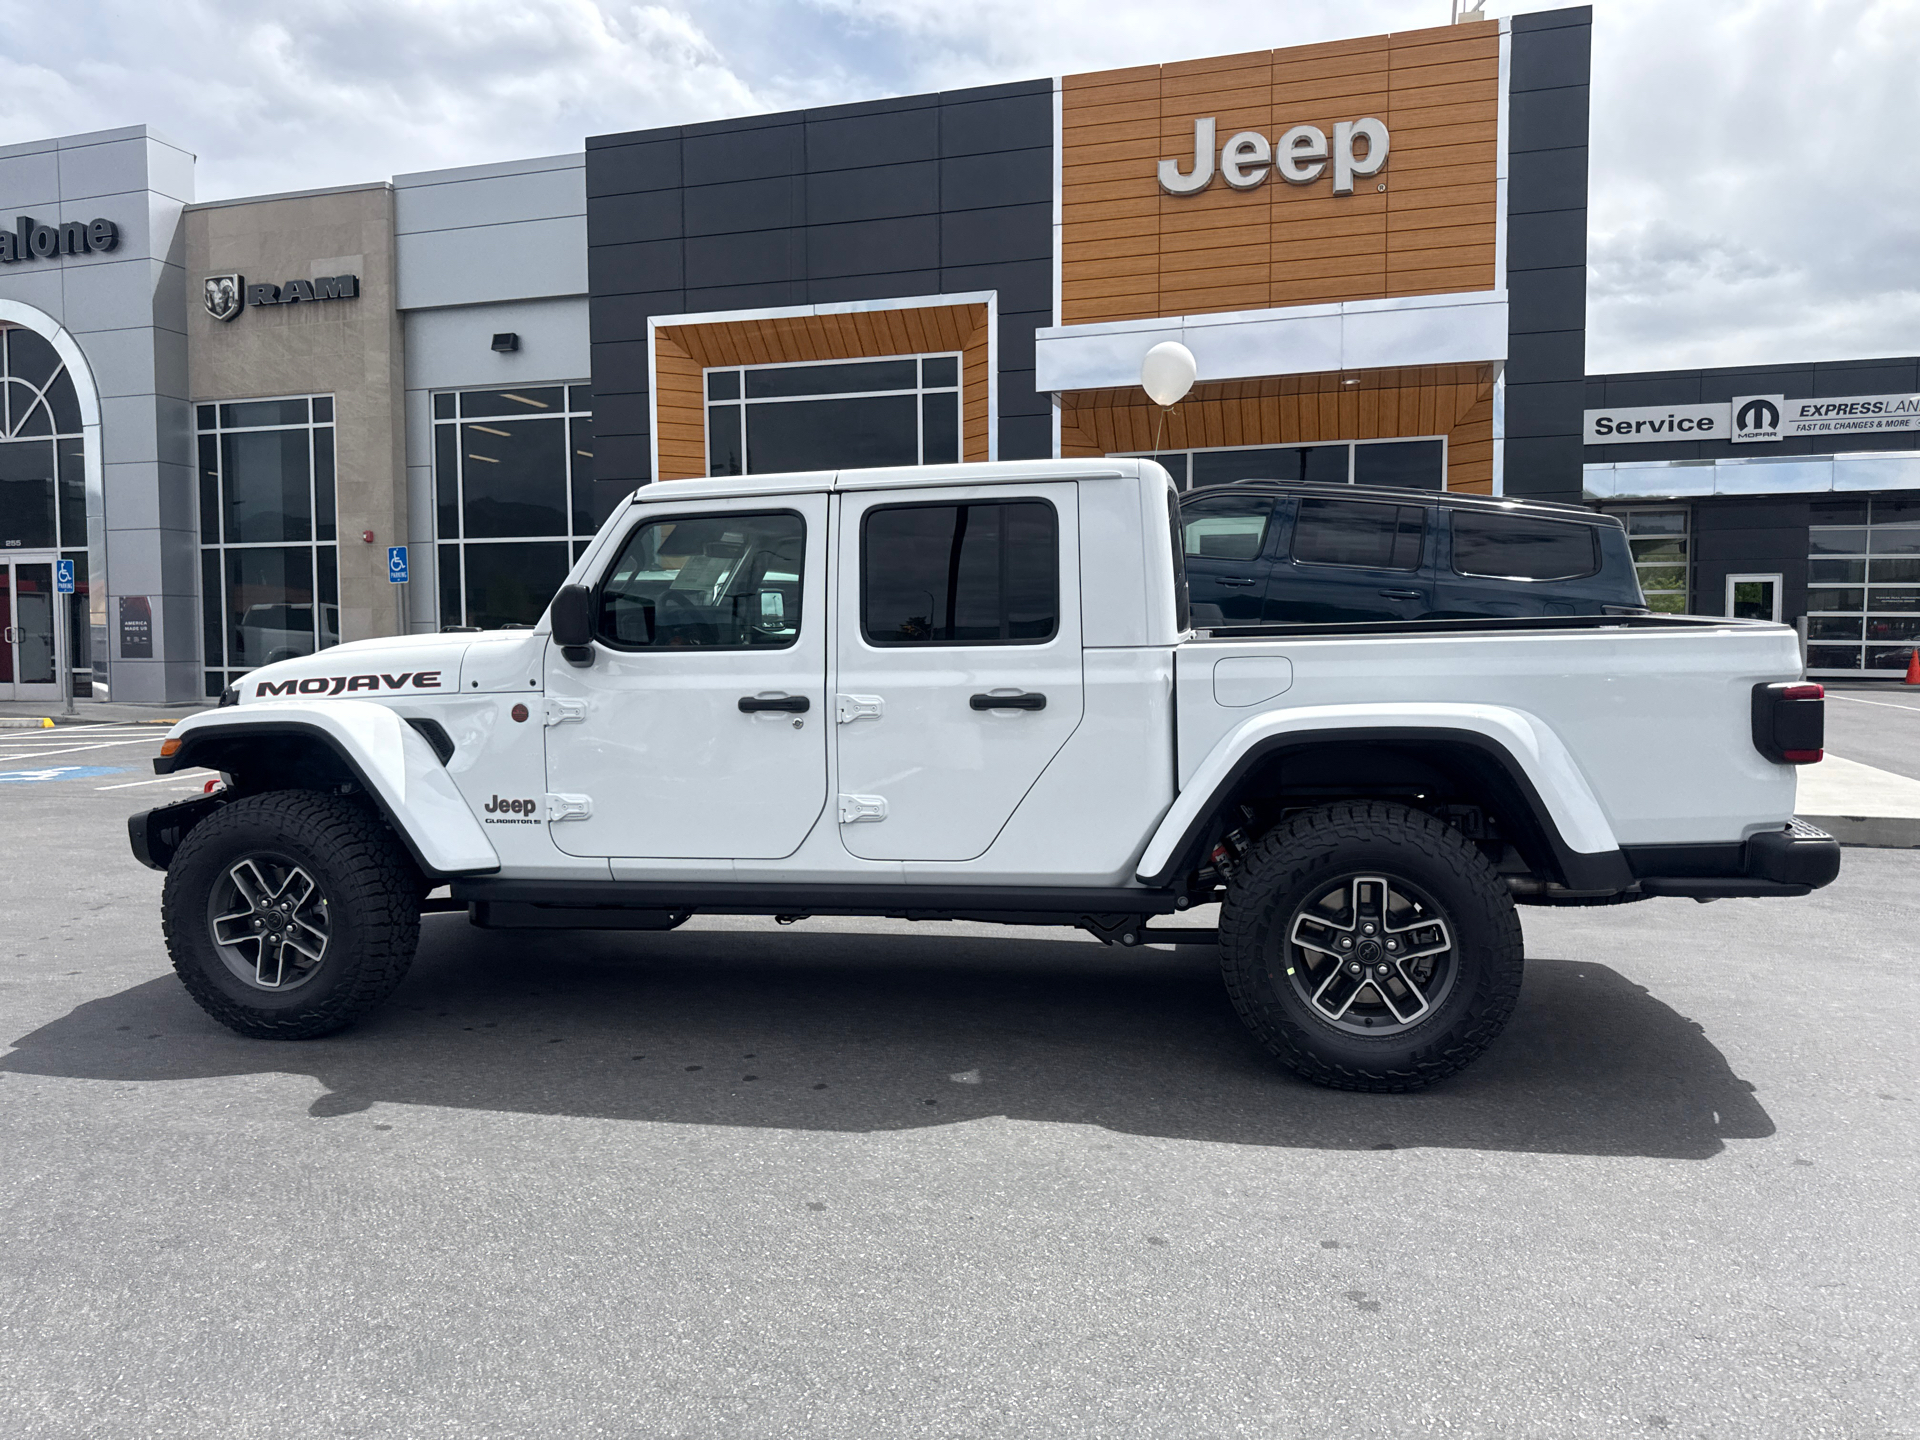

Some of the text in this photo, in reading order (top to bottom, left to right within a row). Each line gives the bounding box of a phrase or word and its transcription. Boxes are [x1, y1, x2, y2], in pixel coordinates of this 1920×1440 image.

[1157, 117, 1390, 197] Jeep
[0, 216, 119, 261] alone
[248, 274, 360, 306] RAM
[1799, 400, 1920, 417] EXPRESSLAN
[1594, 414, 1715, 436] Service
[1796, 419, 1911, 432] FAST OIL CHANGES & MORE
[58, 582, 73, 590] PARKING
[390, 571, 407, 579] PARKING
[256, 671, 442, 697] MOJAVE
[484, 794, 537, 817] Jeep
